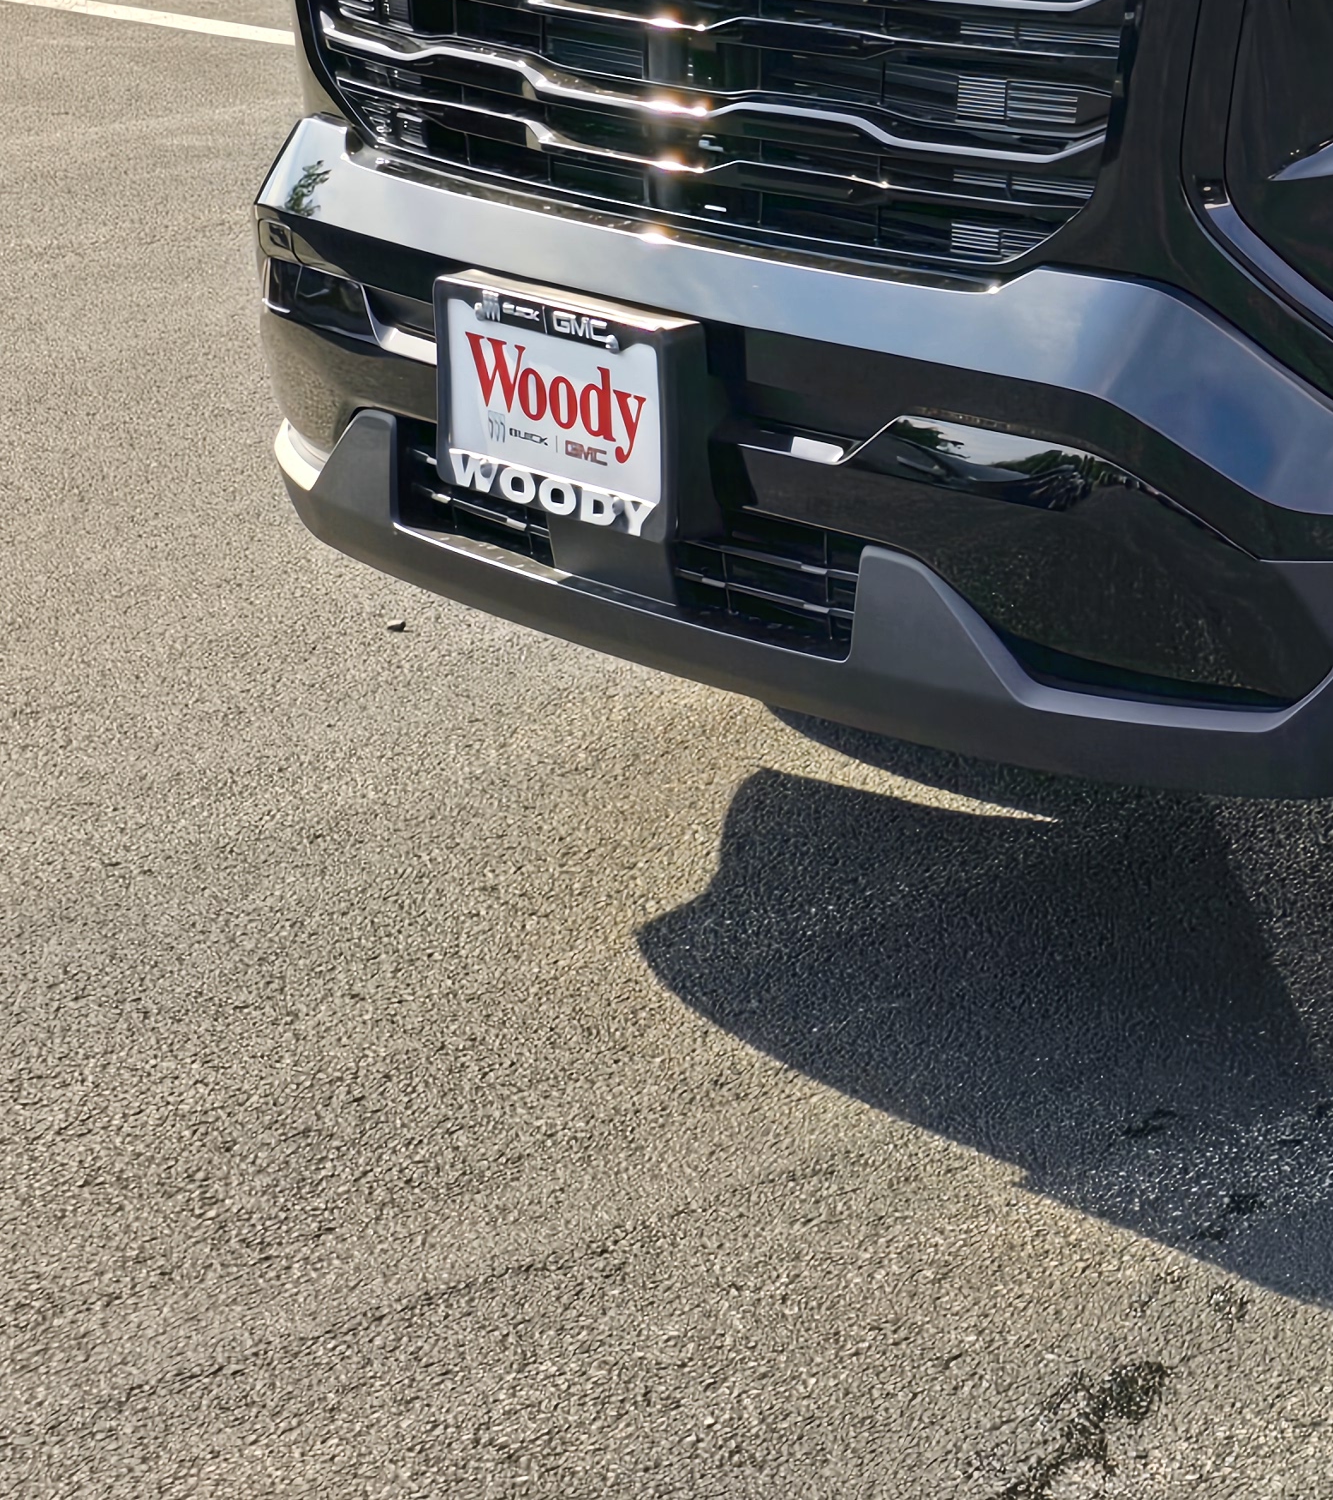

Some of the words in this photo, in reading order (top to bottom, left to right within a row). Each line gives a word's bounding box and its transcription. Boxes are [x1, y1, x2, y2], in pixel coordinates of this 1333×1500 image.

[552, 310, 609, 343] GMC
[465, 331, 647, 464] Woody
[509, 427, 549, 446] BUICK
[564, 439, 609, 467] GMC
[449, 449, 654, 537] WOODY
